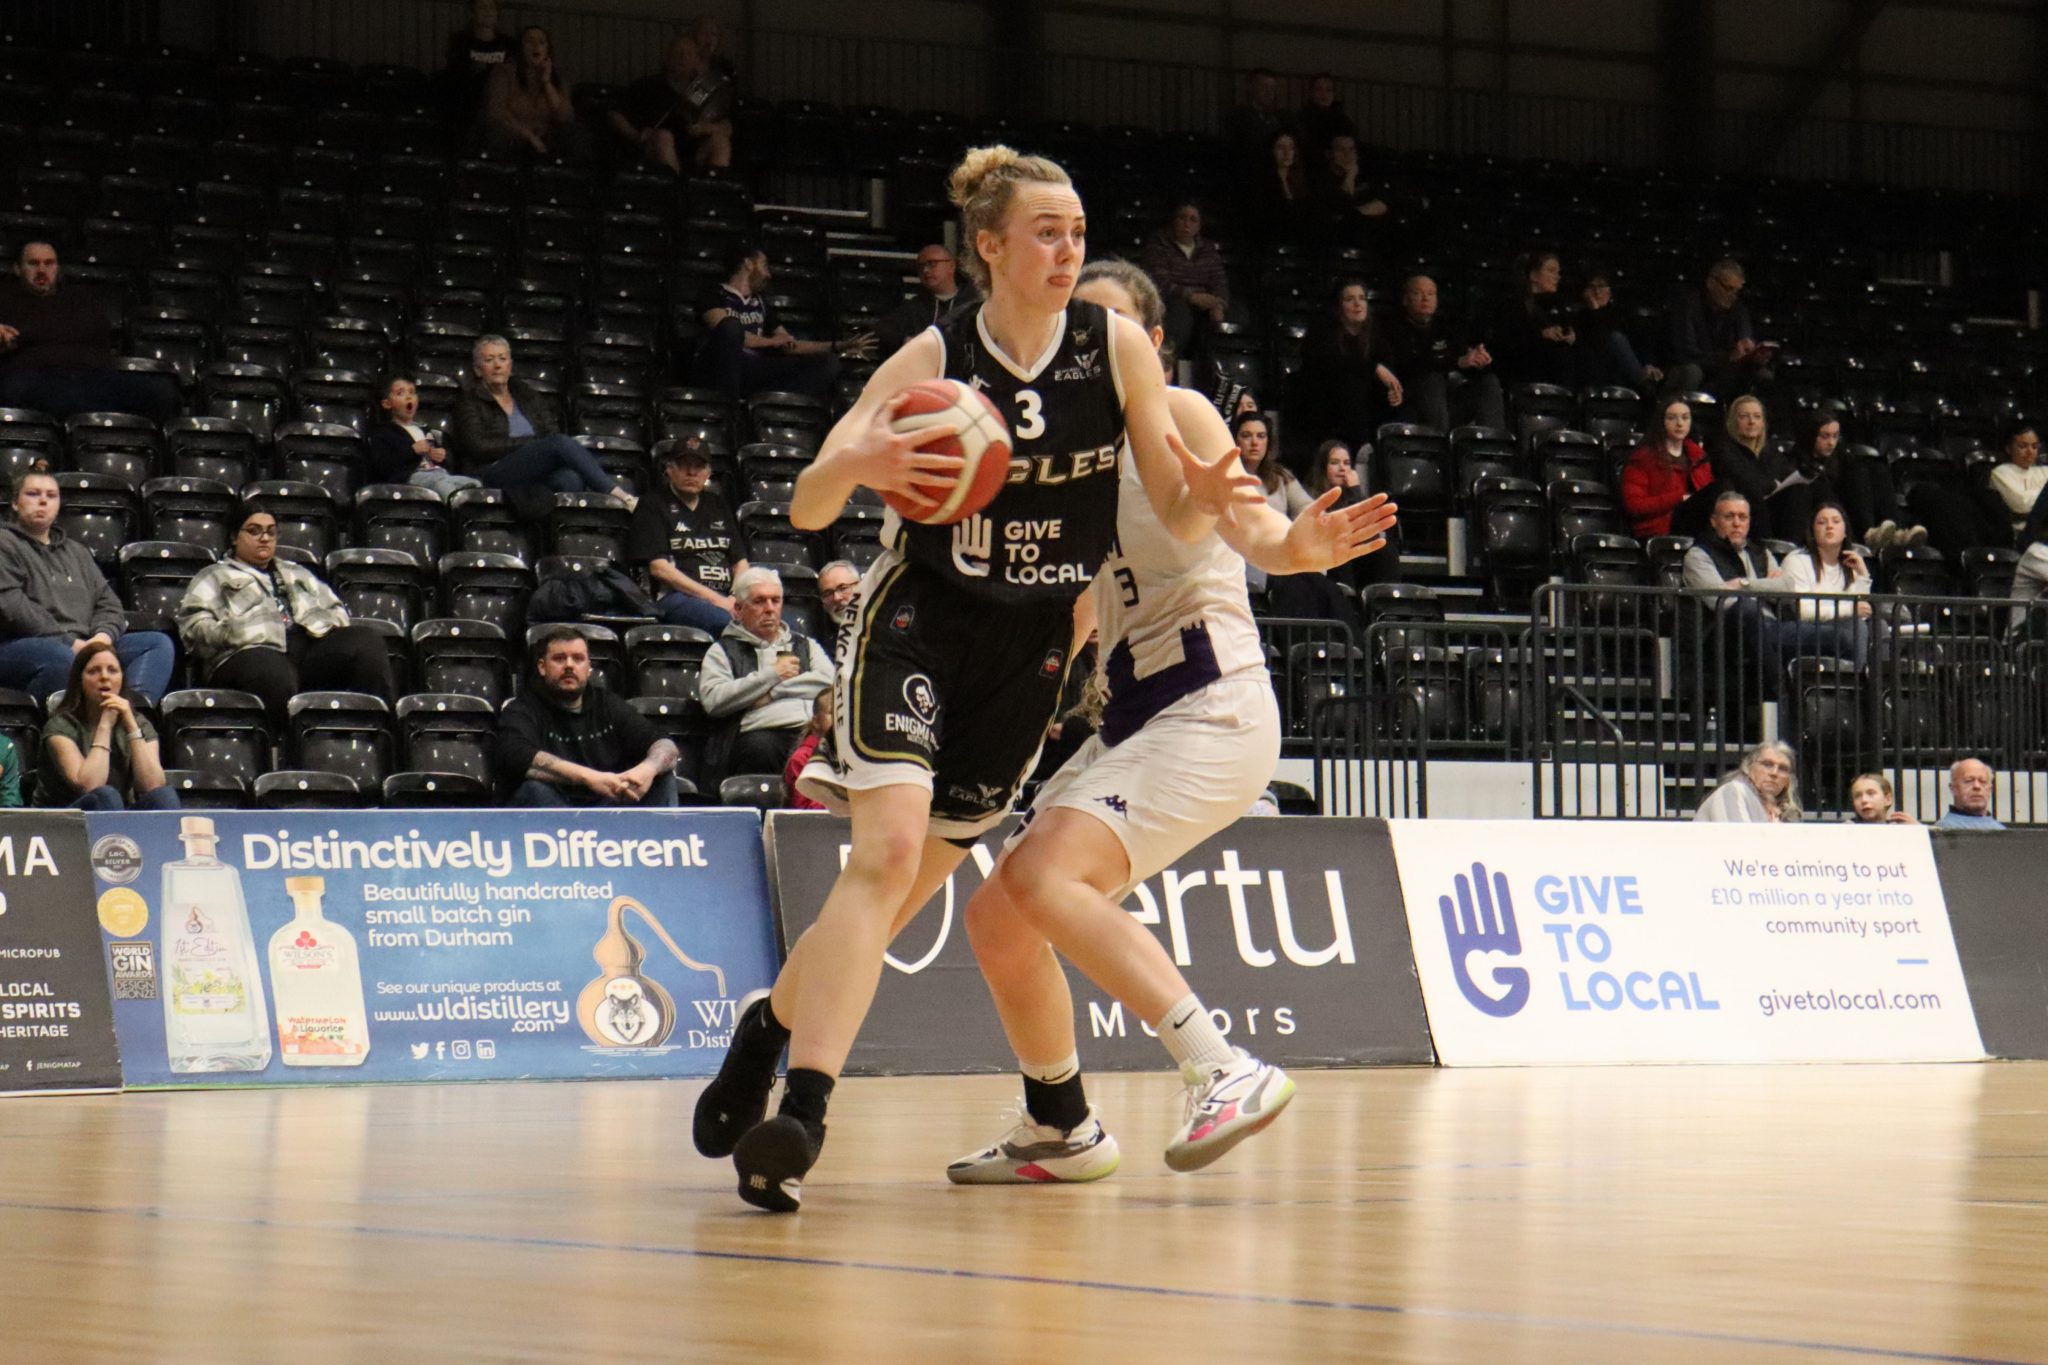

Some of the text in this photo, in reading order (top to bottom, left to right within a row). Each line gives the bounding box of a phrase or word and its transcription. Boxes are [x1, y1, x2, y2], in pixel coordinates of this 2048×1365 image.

[1015, 389, 1046, 440] 3
[1007, 444, 1116, 485] GLES
[1004, 519, 1063, 541] GIVE
[1004, 543, 1041, 563] TO
[1004, 563, 1093, 585] LOCAL
[834, 592, 862, 730] NEWCASTLE
[242, 828, 709, 878] Distinctively Different
[1723, 859, 1908, 882] We're aiming to put
[363, 881, 614, 905] Beautifully handcrafted
[1534, 875, 1644, 914] GIVE
[1711, 888, 1914, 910] £10 million a year into
[365, 904, 532, 927] small batch gin
[368, 928, 514, 947] from Durham
[1766, 917, 1921, 938] community sport
[111, 947, 150, 956] WORLD
[1543, 923, 1613, 963] TO
[113, 955, 152, 971] GIN
[114, 970, 153, 978] AWARDS
[0, 983, 55, 997] LOCAL
[116, 980, 155, 990] DESIGN
[116, 990, 157, 999] BRONZE
[376, 980, 562, 996] See our unique products at
[1558, 970, 1721, 1011] LOCAL
[2, 1002, 81, 1019] SPIRITS
[374, 995, 571, 1025] www.wldistillery
[1758, 989, 1942, 1017] givetolocal.com
[511, 1019, 556, 1033] .com
[1088, 1000, 1297, 1038] Mors
[0, 1025, 69, 1038] HERITAGE
